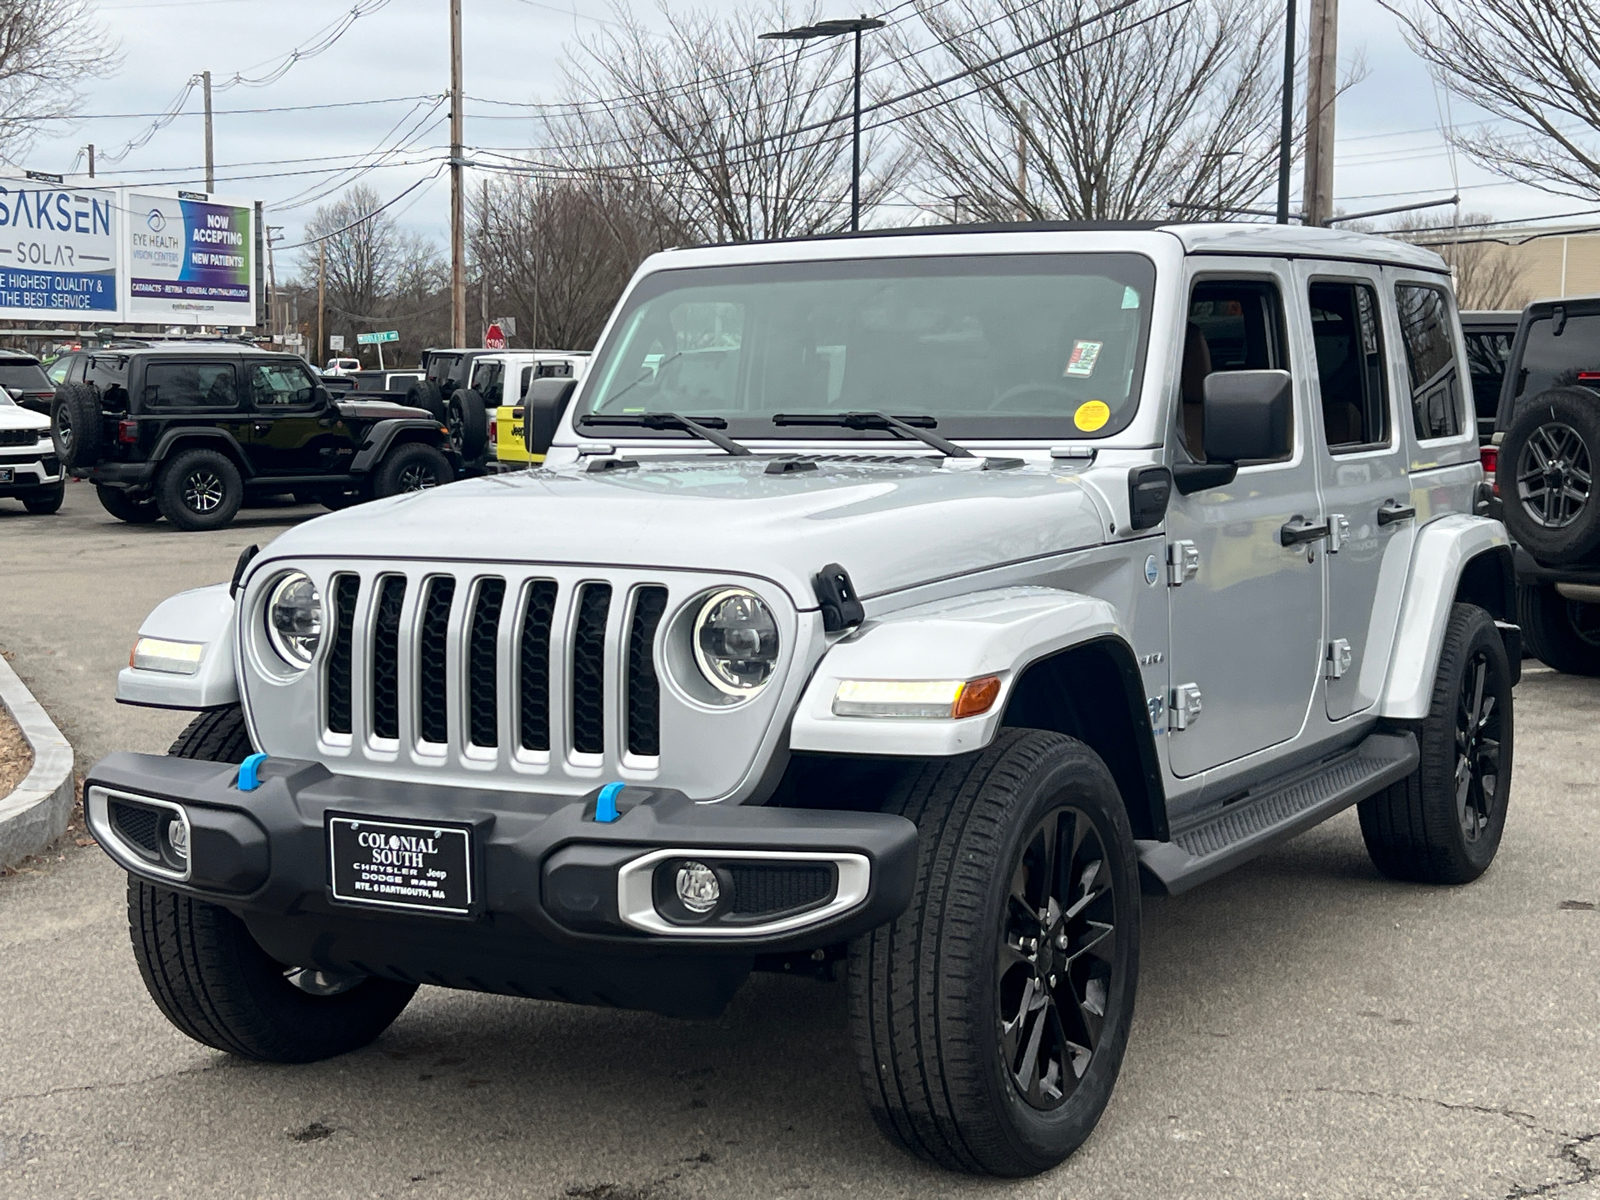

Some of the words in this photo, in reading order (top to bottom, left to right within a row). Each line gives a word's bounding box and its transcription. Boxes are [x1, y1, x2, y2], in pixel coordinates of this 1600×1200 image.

[207, 214, 229, 229] NOW
[133, 234, 147, 246] EYE
[149, 235, 178, 249] HEALTH
[193, 229, 242, 246] ACCEPTING
[18, 242, 74, 266] SOLAR
[133, 250, 152, 260] VISION
[154, 251, 178, 262] CENTERS
[192, 252, 208, 264] NEW
[210, 254, 244, 267] PATIENTS!
[9, 274, 52, 290] HIGHEST
[54, 277, 94, 292] QUALITY
[96, 280, 103, 292] &
[132, 283, 161, 292] CATARACTS
[164, 285, 182, 293] RETINA
[186, 286, 207, 295] GENERAL
[208, 287, 248, 297] OPHTHALMOLOGY
[1, 291, 20, 306] THE
[24, 292, 48, 306] BEST
[51, 293, 90, 308] SERVICE
[487, 339, 505, 349] STOP
[358, 832, 438, 854] COLONIAL
[372, 848, 423, 867] SOUTH
[353, 862, 418, 876] CHRYSLER
[426, 868, 447, 880] Jeep
[362, 872, 402, 883] DODGE
[411, 879, 437, 887] RAM
[355, 882, 372, 890] RTE.
[380, 885, 431, 898] DARTMOUTH,
[432, 890, 445, 899] MA
